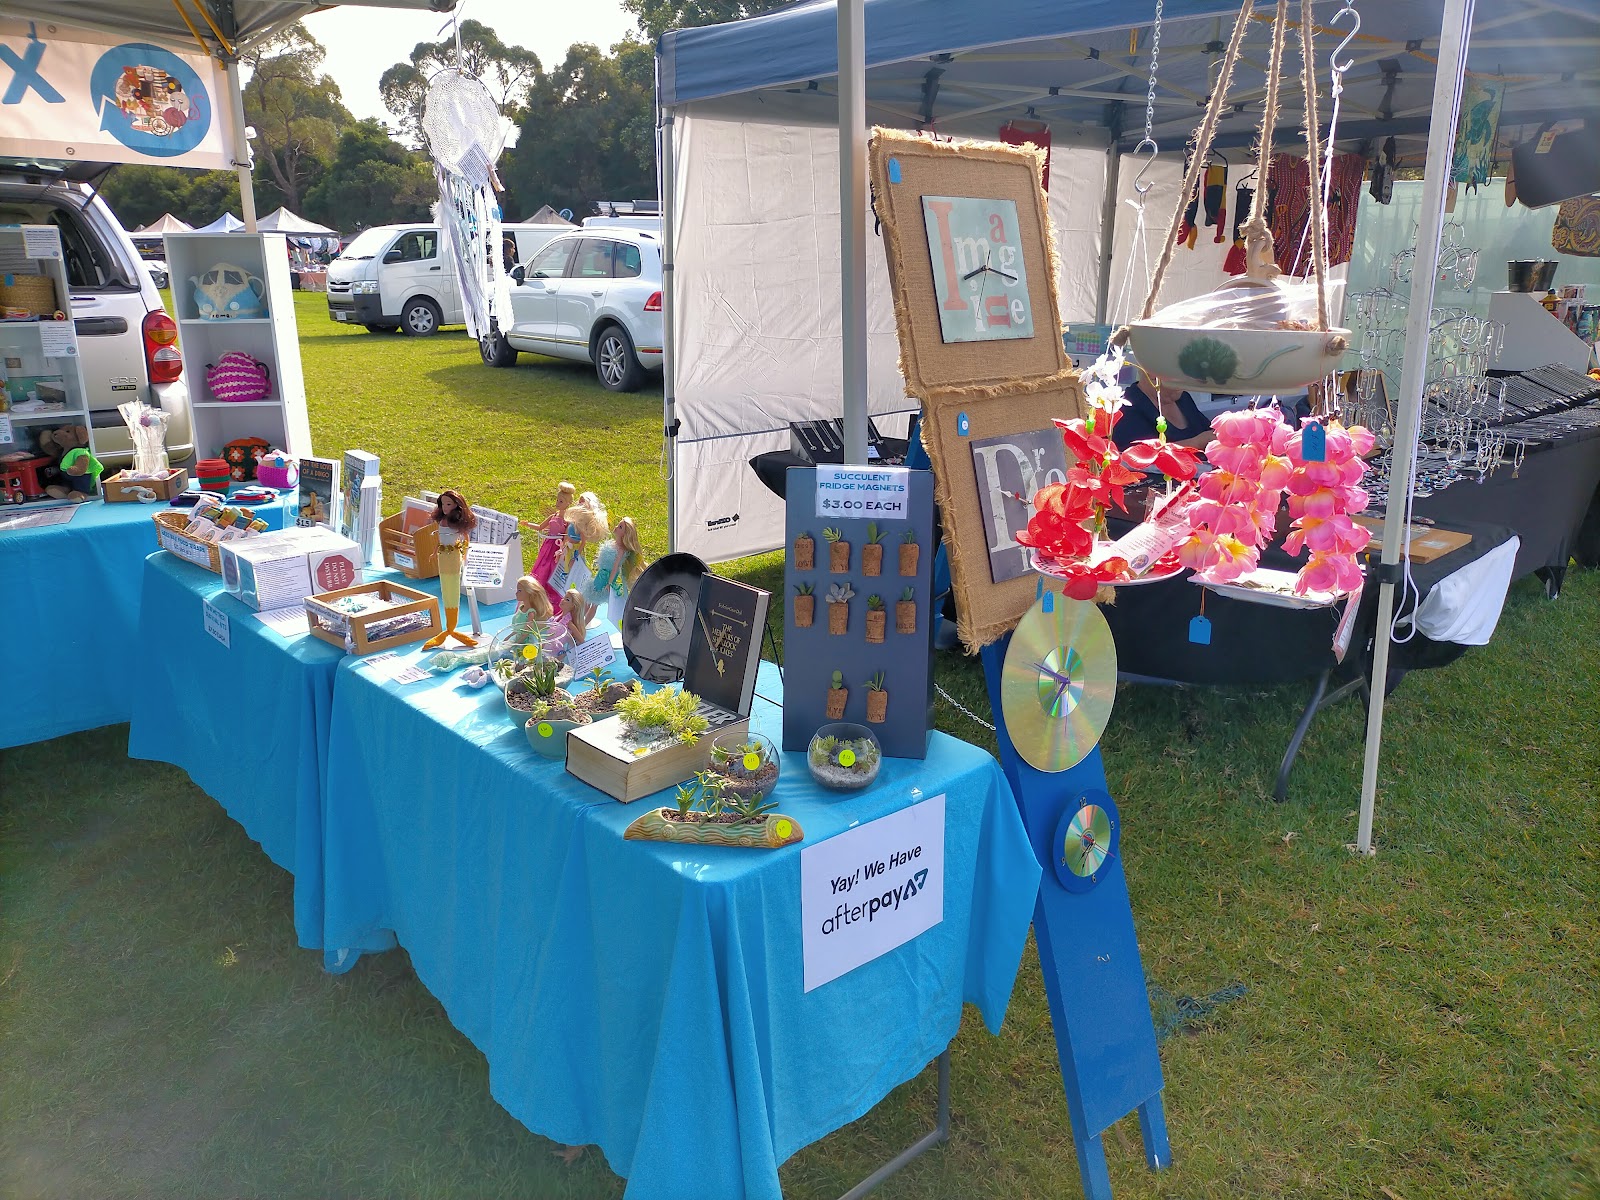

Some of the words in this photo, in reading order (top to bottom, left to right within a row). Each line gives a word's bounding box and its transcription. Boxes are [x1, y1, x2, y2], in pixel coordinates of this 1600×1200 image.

[834, 473, 891, 482] SUCCULENT
[820, 482, 855, 490] FRIDGE
[857, 483, 905, 492] MAGNETS
[822, 498, 863, 509] $3.00
[865, 501, 902, 511] EACH
[331, 562, 338, 572] DO
[339, 561, 347, 583] PLEASE
[324, 562, 333, 588] DISTURB
[722, 623, 732, 633] THE
[1079, 796, 1087, 808] 12
[1110, 820, 1115, 830] 3
[830, 868, 860, 895] Yay!
[864, 860, 885, 880] We
[888, 845, 922, 870] Have
[1091, 873, 1097, 883] 6
[821, 885, 904, 935] afterpay
